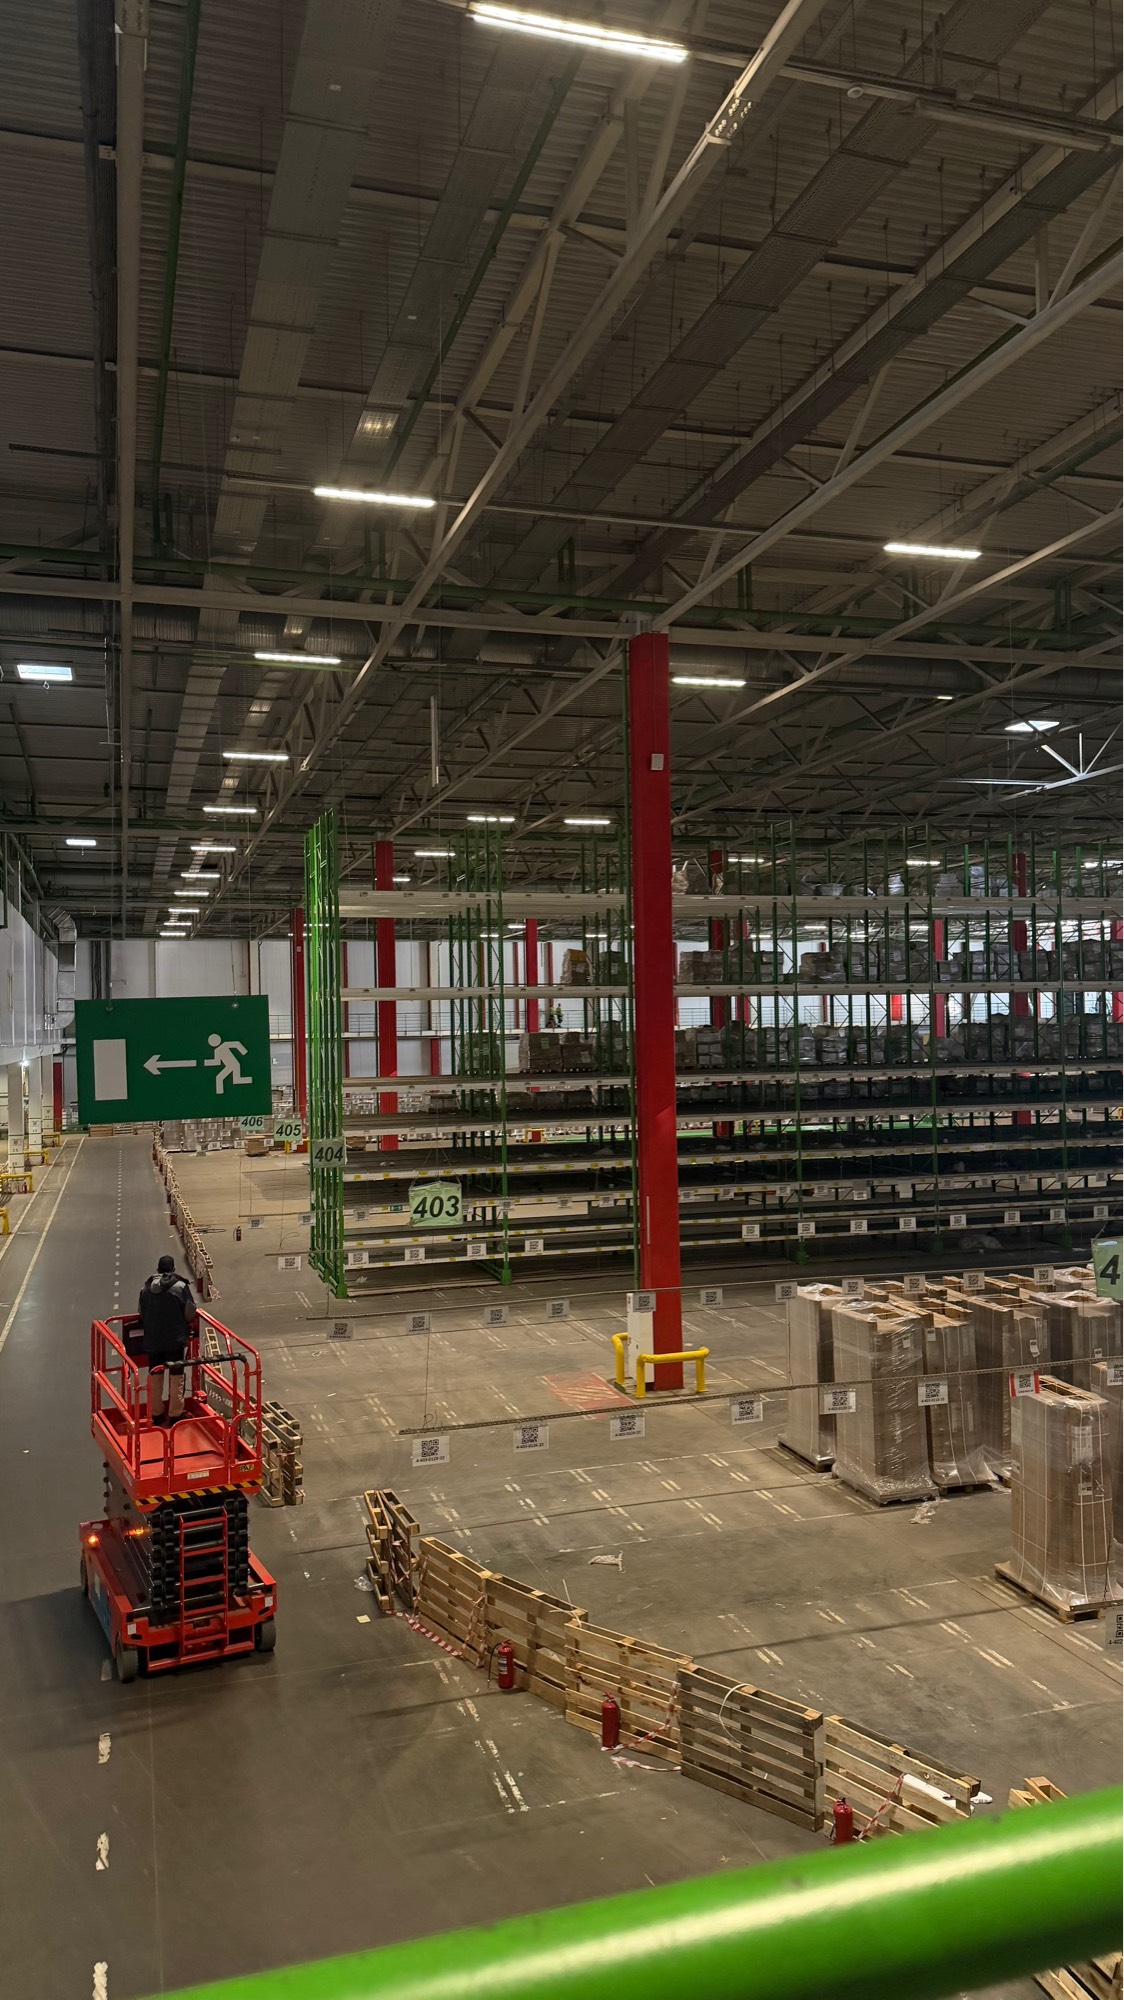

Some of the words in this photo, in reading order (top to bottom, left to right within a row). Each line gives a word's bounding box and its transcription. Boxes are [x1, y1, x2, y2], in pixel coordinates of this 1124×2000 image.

[241, 1116, 263, 1127] 406
[276, 1124, 301, 1136] 405
[315, 1146, 343, 1162] 404
[413, 1195, 460, 1218] 403
